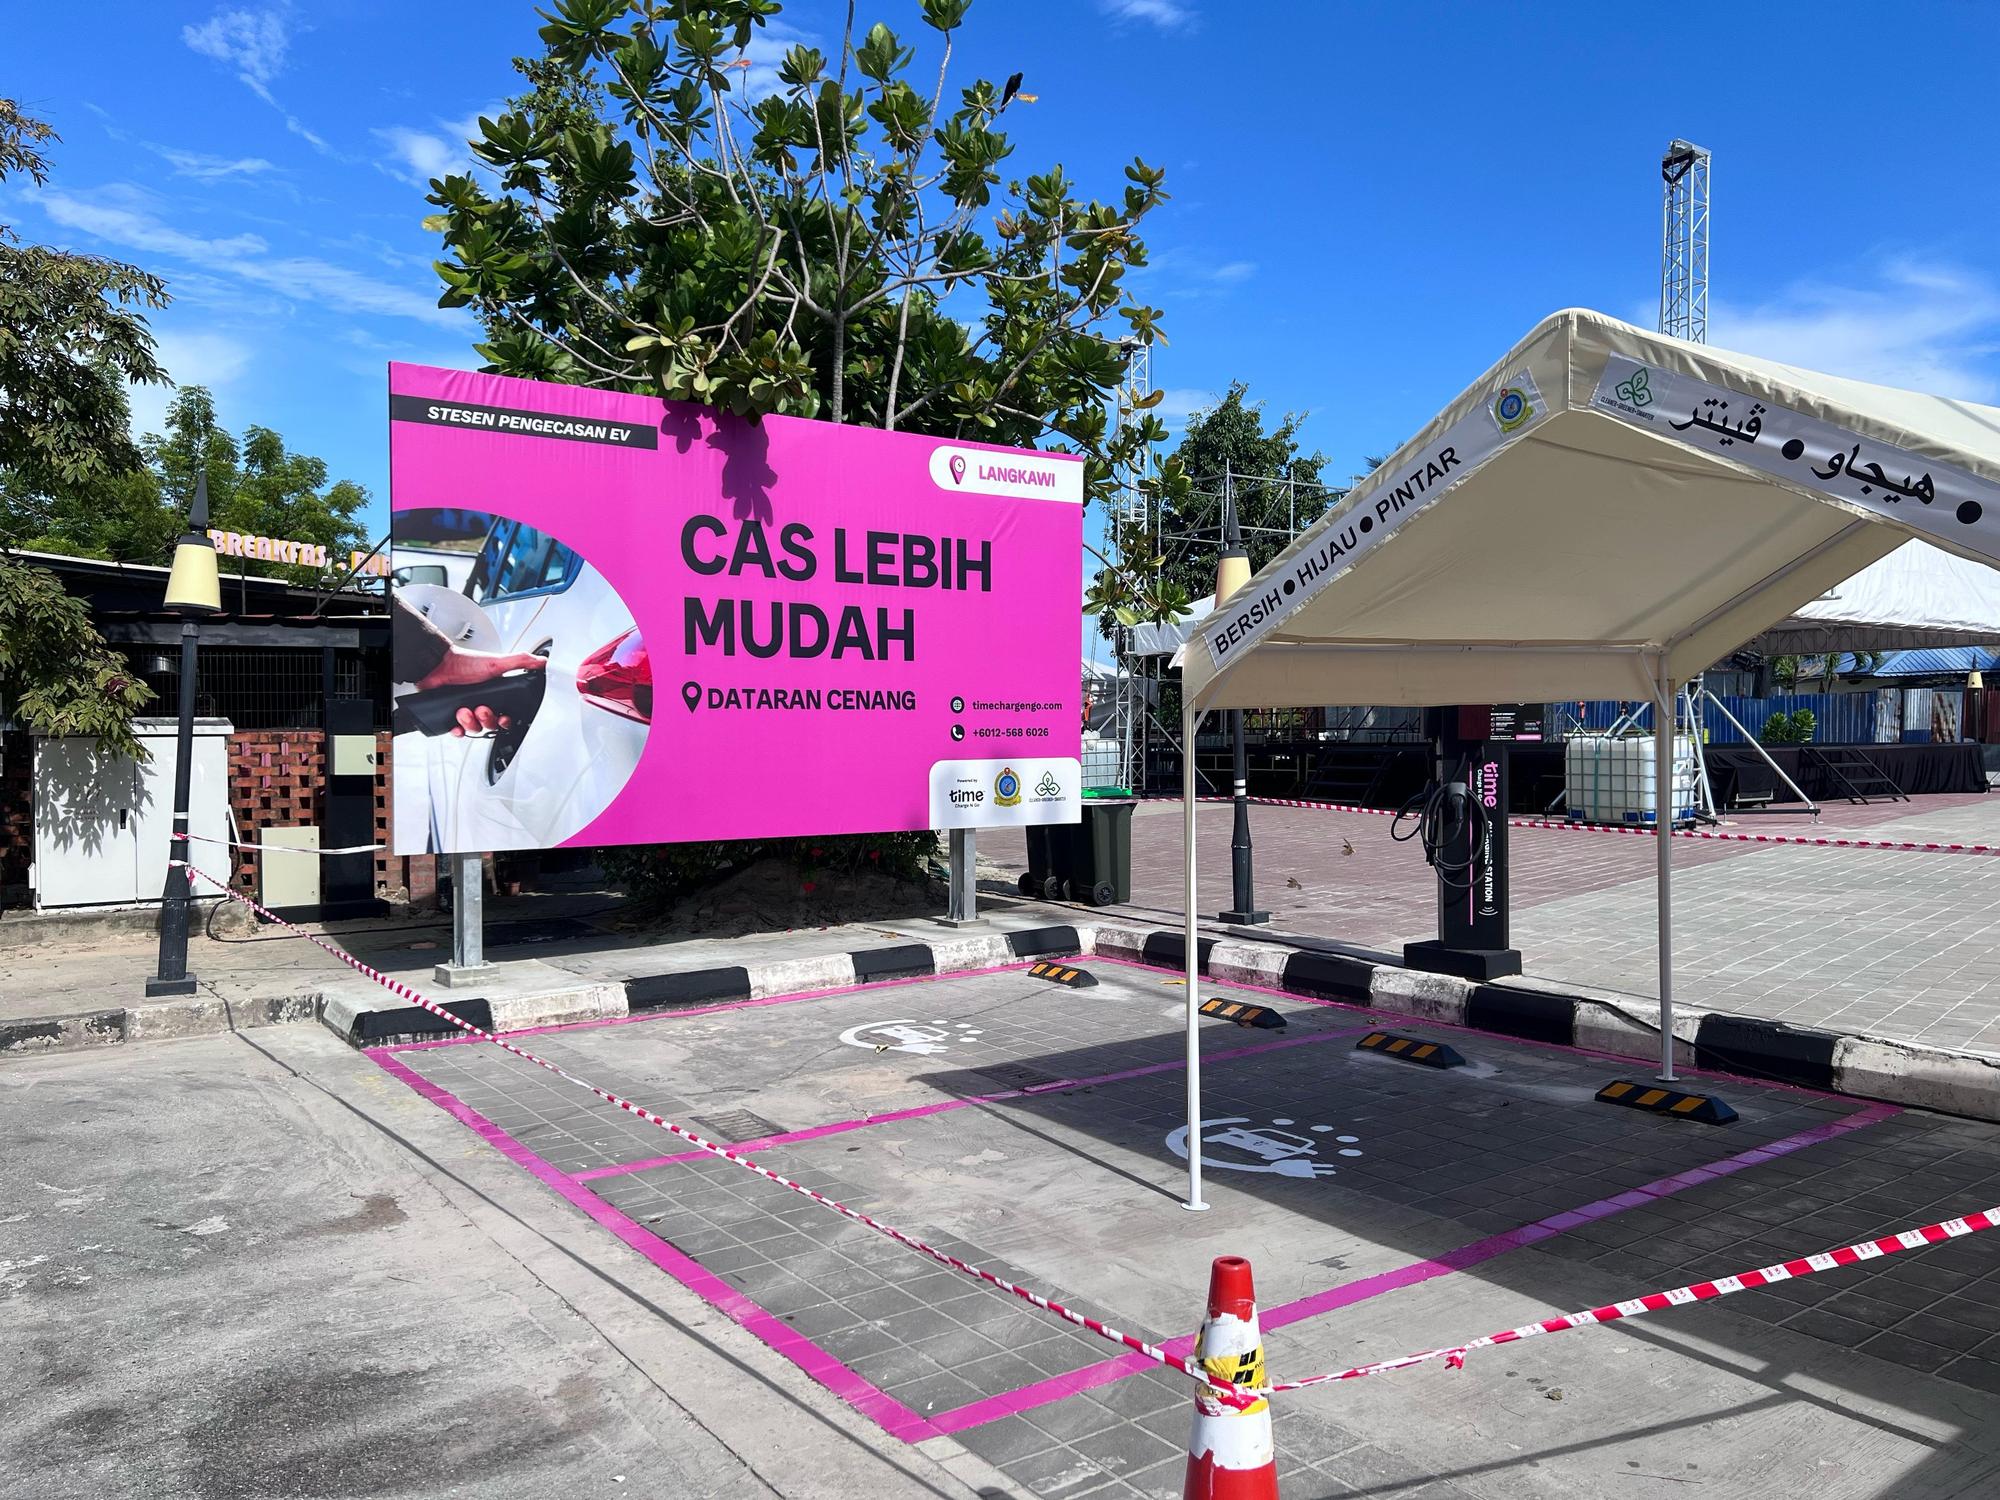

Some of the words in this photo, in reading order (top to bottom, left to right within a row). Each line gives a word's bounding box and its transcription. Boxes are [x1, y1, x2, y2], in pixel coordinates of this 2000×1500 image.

[427, 406, 495, 426] STESEN
[498, 414, 607, 439] PENGECASAN
[609, 427, 631, 442] EV
[978, 465, 1056, 487] LANGKAWI
[1811, 443, 1935, 505] هيجاو
[680, 514, 817, 582] CAS
[834, 527, 992, 592] LEBIH
[1214, 588, 1283, 655] BERSIH
[1296, 526, 1358, 587] HIJAU
[1375, 446, 1462, 523] PINTAR
[684, 596, 915, 661] MUDAH
[707, 688, 821, 710] DATARAN
[827, 689, 916, 711] CENANG
[972, 700, 1063, 713] timechargengo.com
[972, 728, 1023, 738] +6012-568
[1025, 727, 1049, 737] 6026
[949, 789, 984, 803] time
[1483, 761, 1499, 807] time
[1485, 866, 1493, 902] STATION
